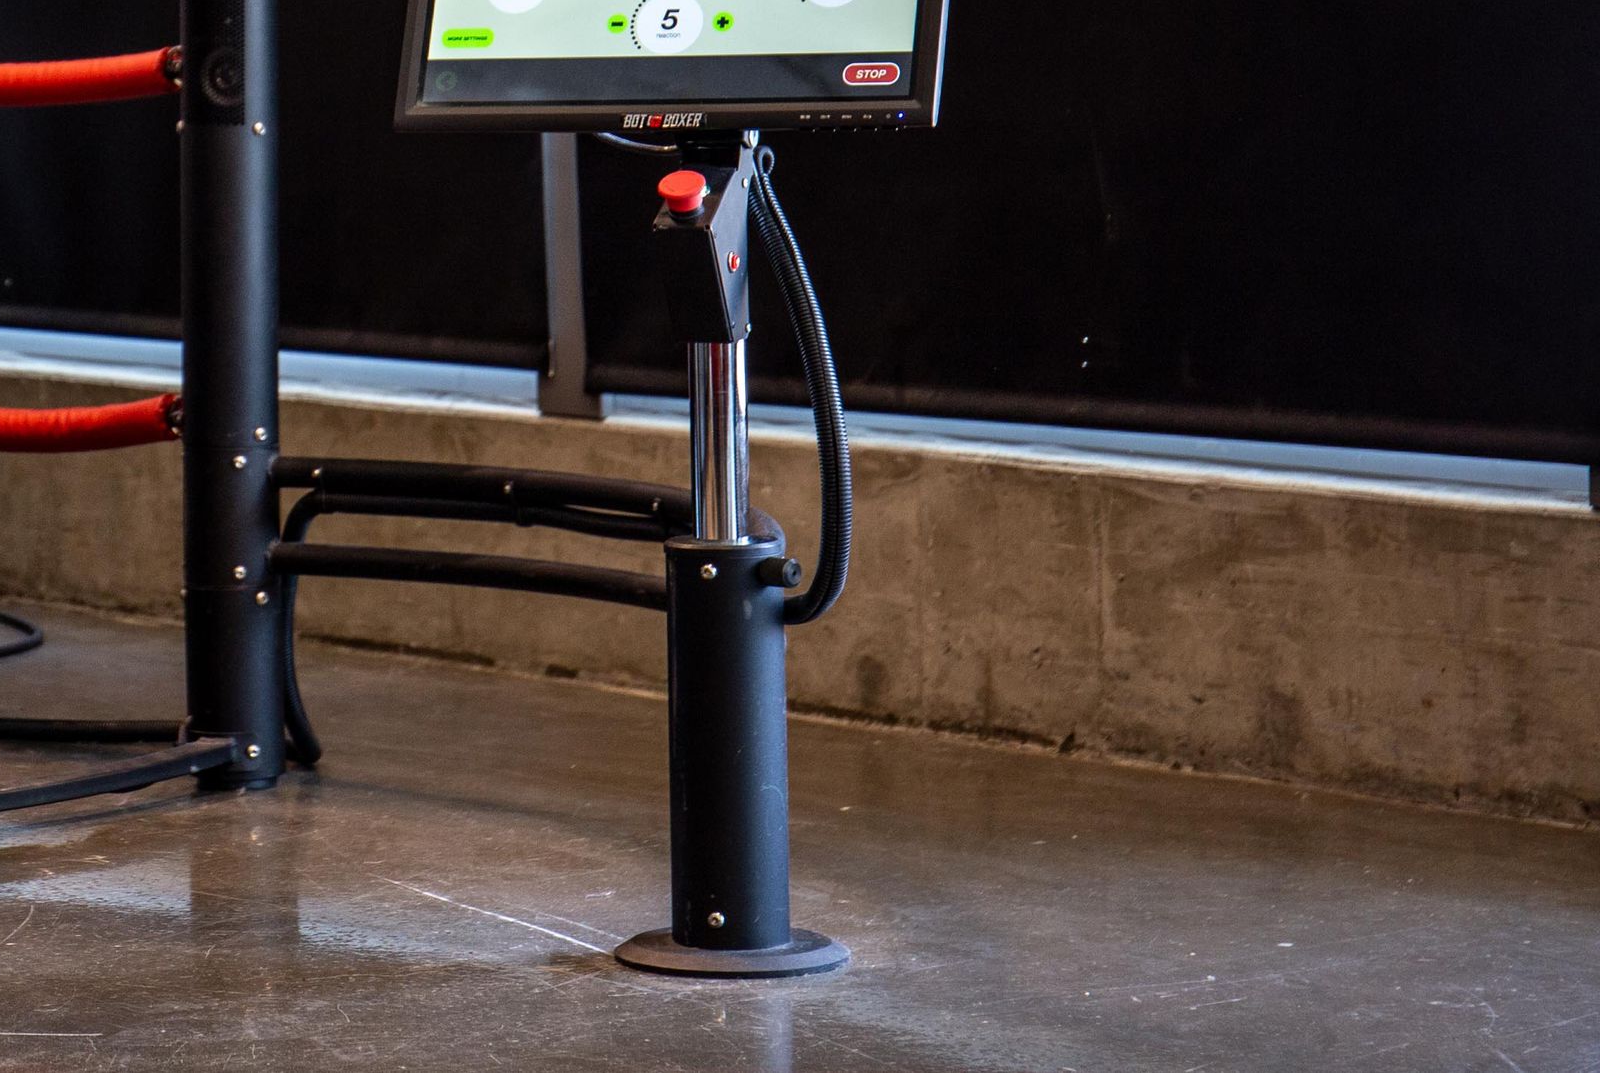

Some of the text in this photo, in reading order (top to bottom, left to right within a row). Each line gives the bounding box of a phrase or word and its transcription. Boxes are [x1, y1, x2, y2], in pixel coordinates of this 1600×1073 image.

[660, 9, 680, 30] 5
[855, 69, 887, 79] STOP
[623, 113, 703, 129] BOT BOXER
